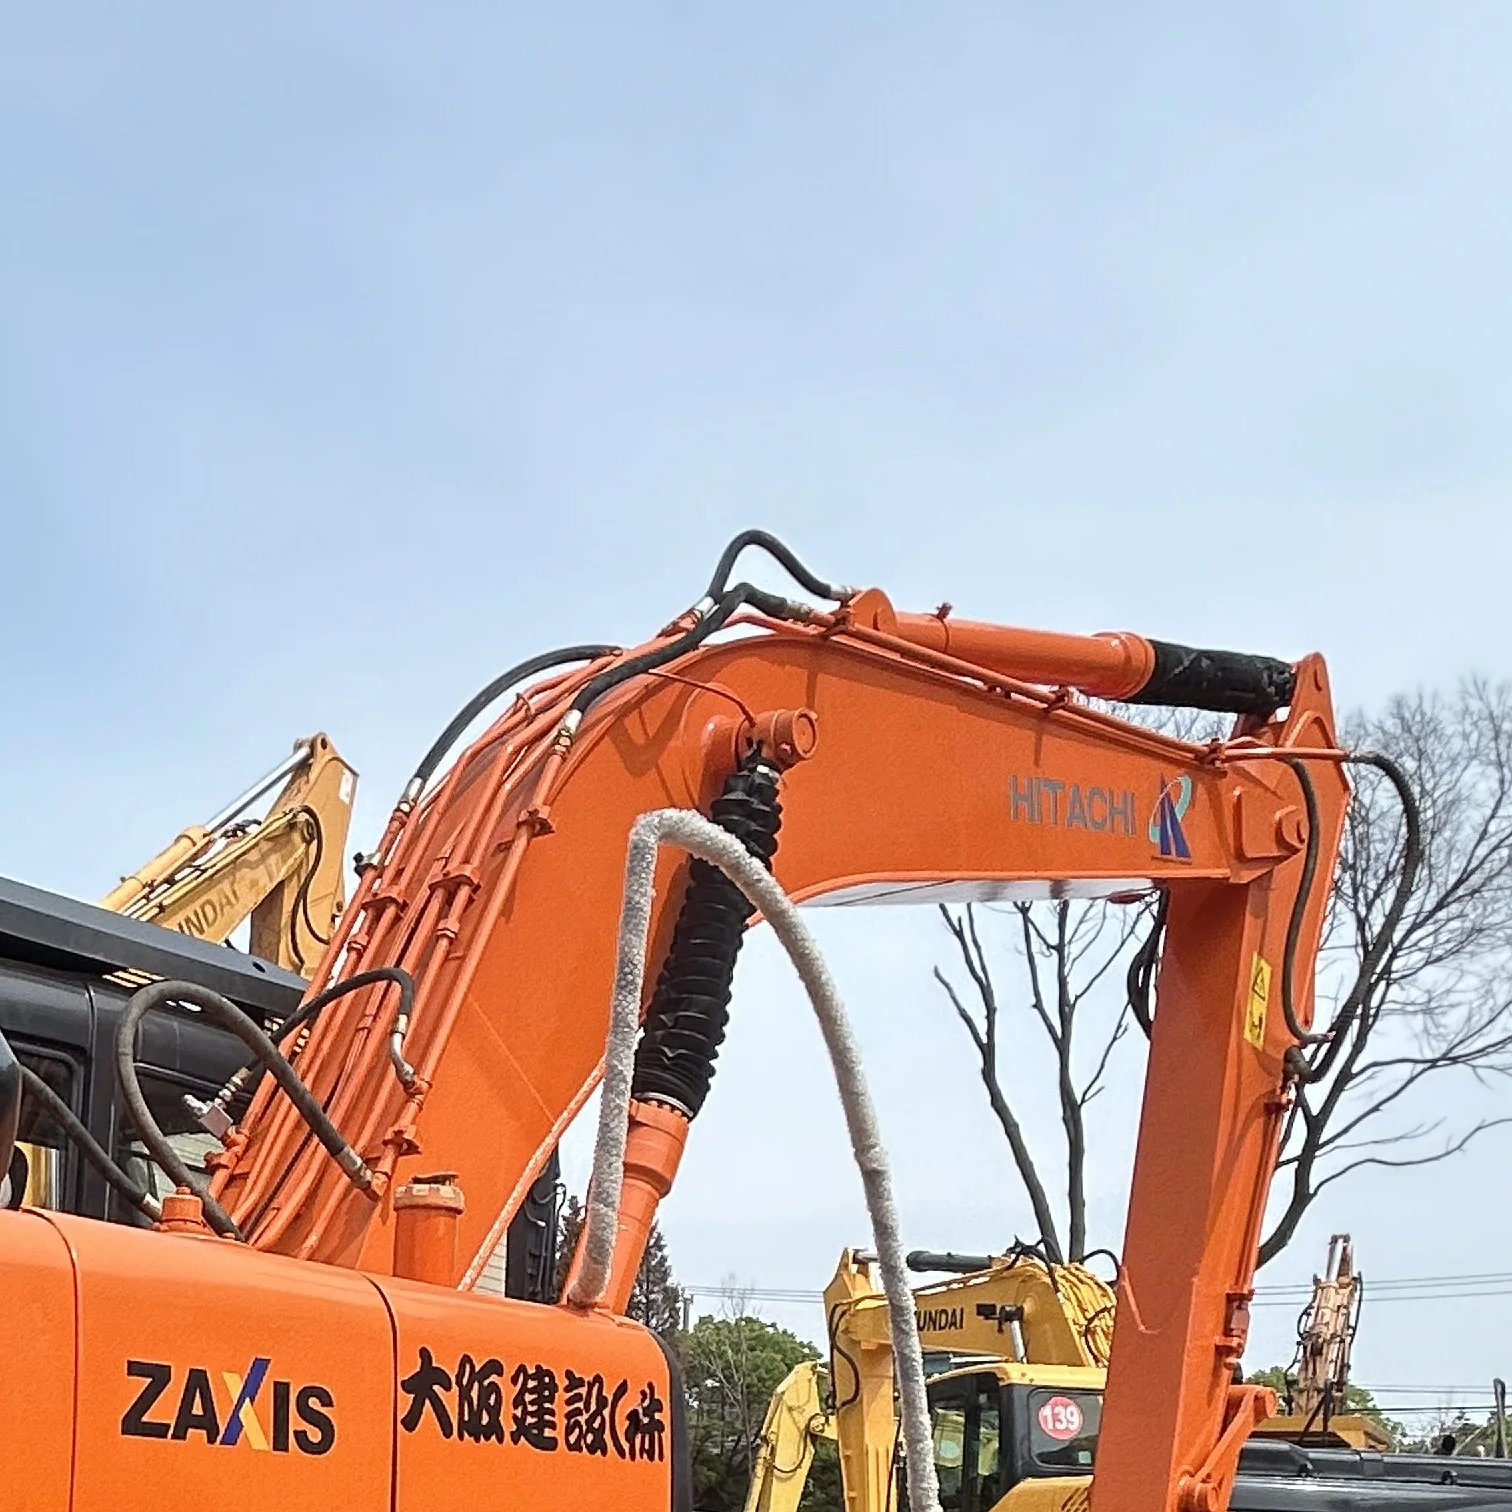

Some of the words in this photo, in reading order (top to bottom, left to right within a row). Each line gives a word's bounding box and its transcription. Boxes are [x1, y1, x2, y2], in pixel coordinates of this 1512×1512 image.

[1008, 773, 1137, 837] HITACHI
[177, 875, 240, 936] NDAI
[914, 1306, 964, 1332] UNDAI
[121, 1356, 336, 1456] ZAXIS
[1041, 1405, 1080, 1431] 139
